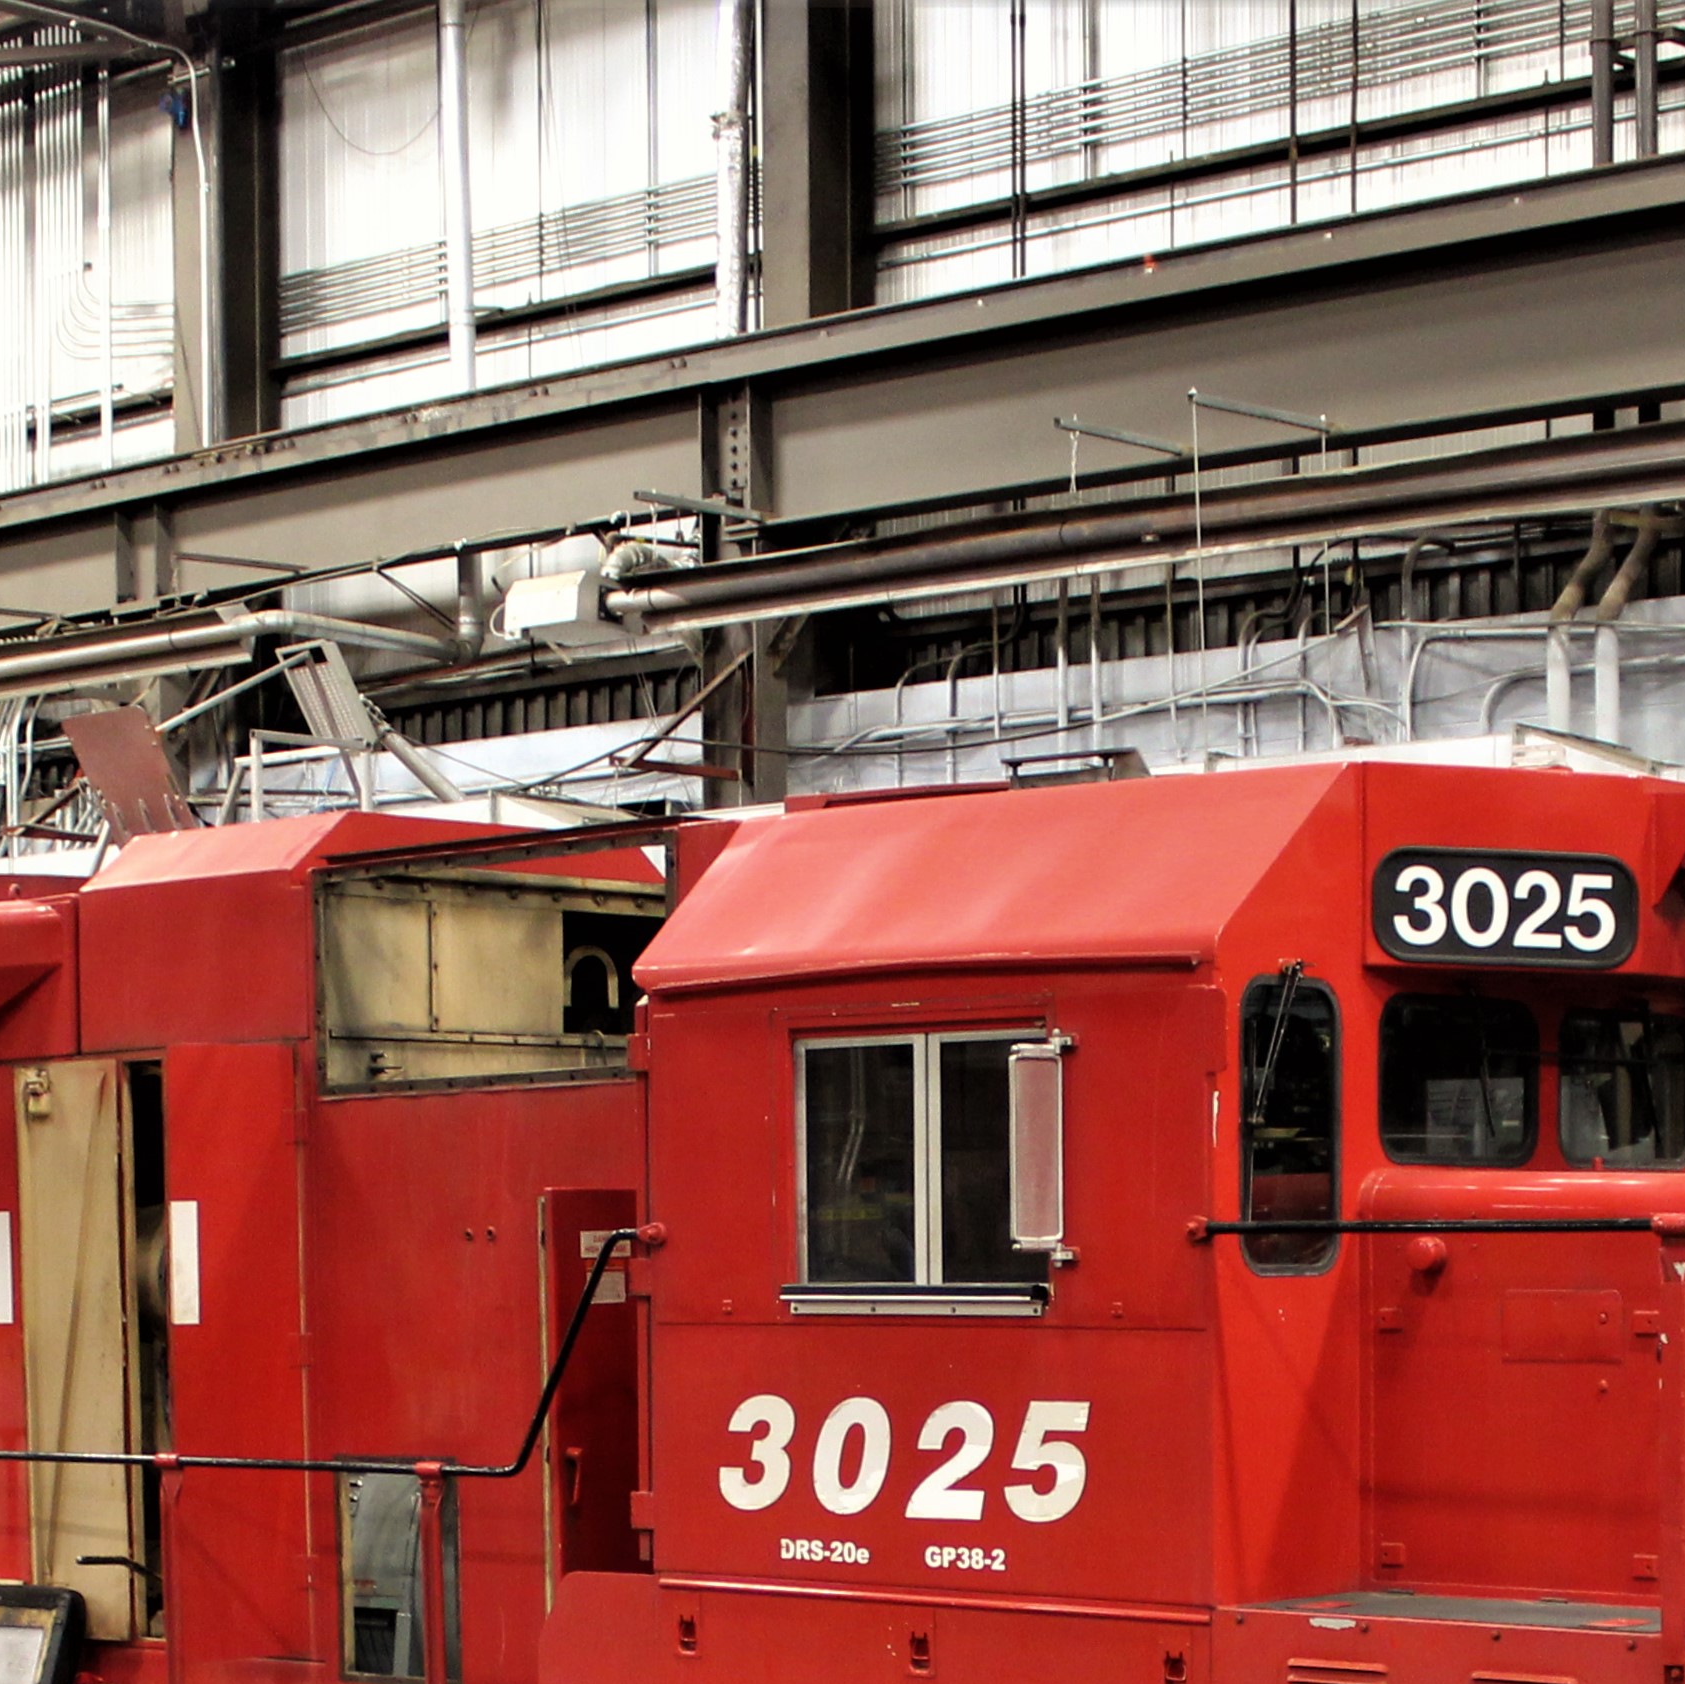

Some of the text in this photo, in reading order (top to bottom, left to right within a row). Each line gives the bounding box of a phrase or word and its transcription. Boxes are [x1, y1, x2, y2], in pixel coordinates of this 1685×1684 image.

[1393, 865, 1616, 952] 3025
[718, 1394, 1091, 1524] 3025
[780, 1538, 1006, 1571] DRS-20e GP38-2
